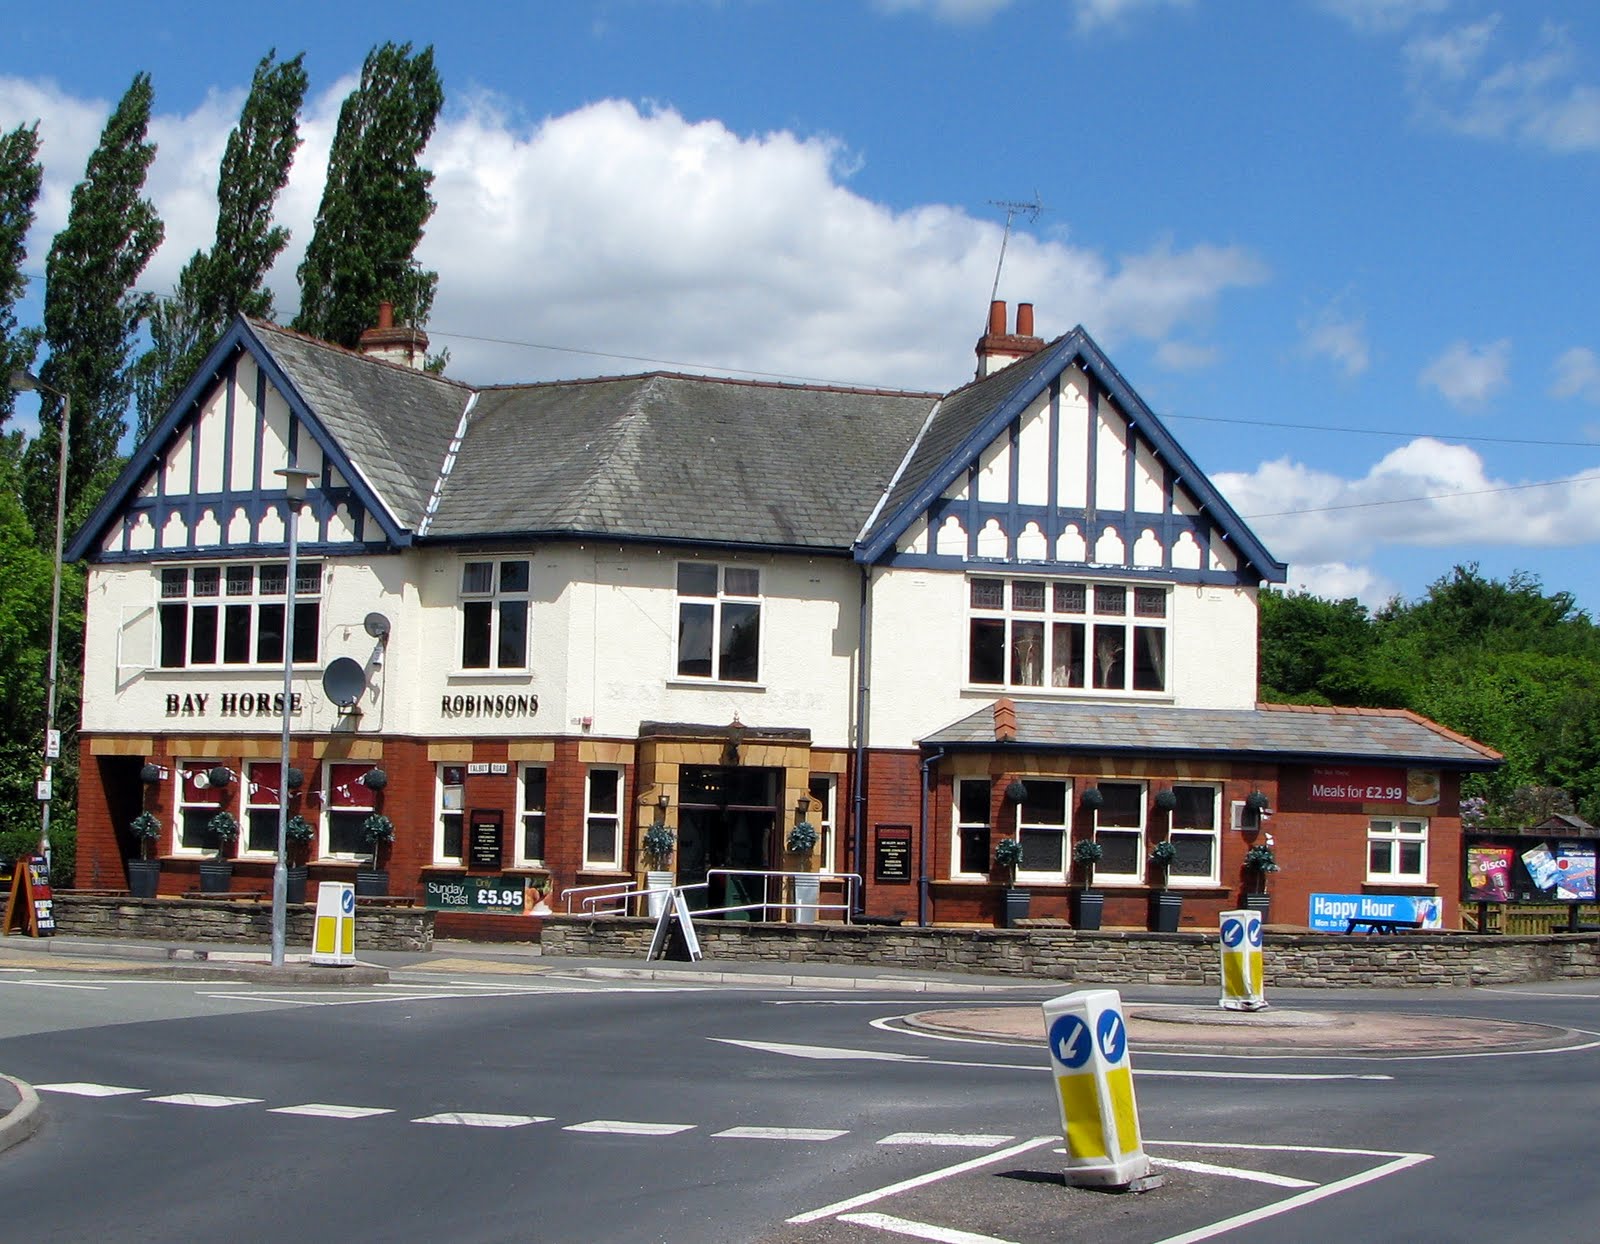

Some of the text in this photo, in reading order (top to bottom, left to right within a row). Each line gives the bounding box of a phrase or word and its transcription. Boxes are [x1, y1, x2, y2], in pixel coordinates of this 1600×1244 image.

[166, 692, 302, 712] BAY HORSE
[441, 694, 539, 713] ROBINSONS
[1312, 784, 1402, 799] Meals for £2.99
[1479, 859, 1507, 872] disco
[428, 882, 465, 896] Sunday
[441, 893, 469, 905] Roast
[477, 889, 523, 906] £5.95
[37, 910, 50, 919] EAT
[1314, 897, 1395, 919] Happy Hour
[37, 919, 56, 929] FREE
